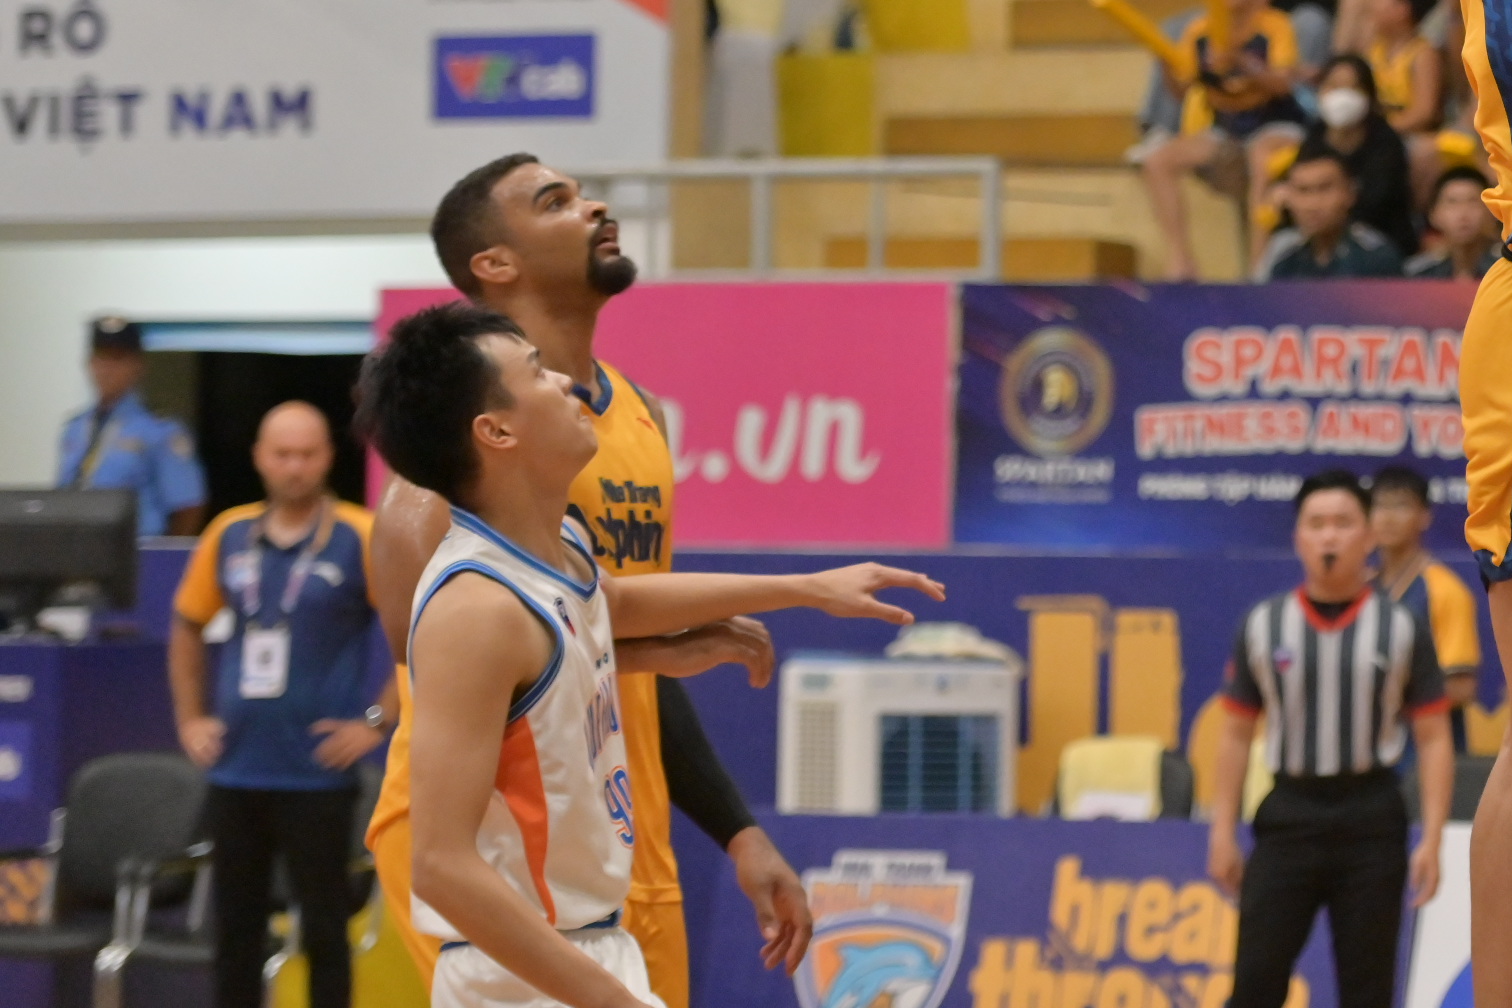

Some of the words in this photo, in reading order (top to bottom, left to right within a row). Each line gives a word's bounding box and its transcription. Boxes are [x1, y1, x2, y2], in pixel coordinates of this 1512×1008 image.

[167, 84, 316, 139] NAM
[1134, 400, 1311, 460] FITNESS
[1310, 400, 1406, 456] AND
[1051, 855, 1240, 965] brea
